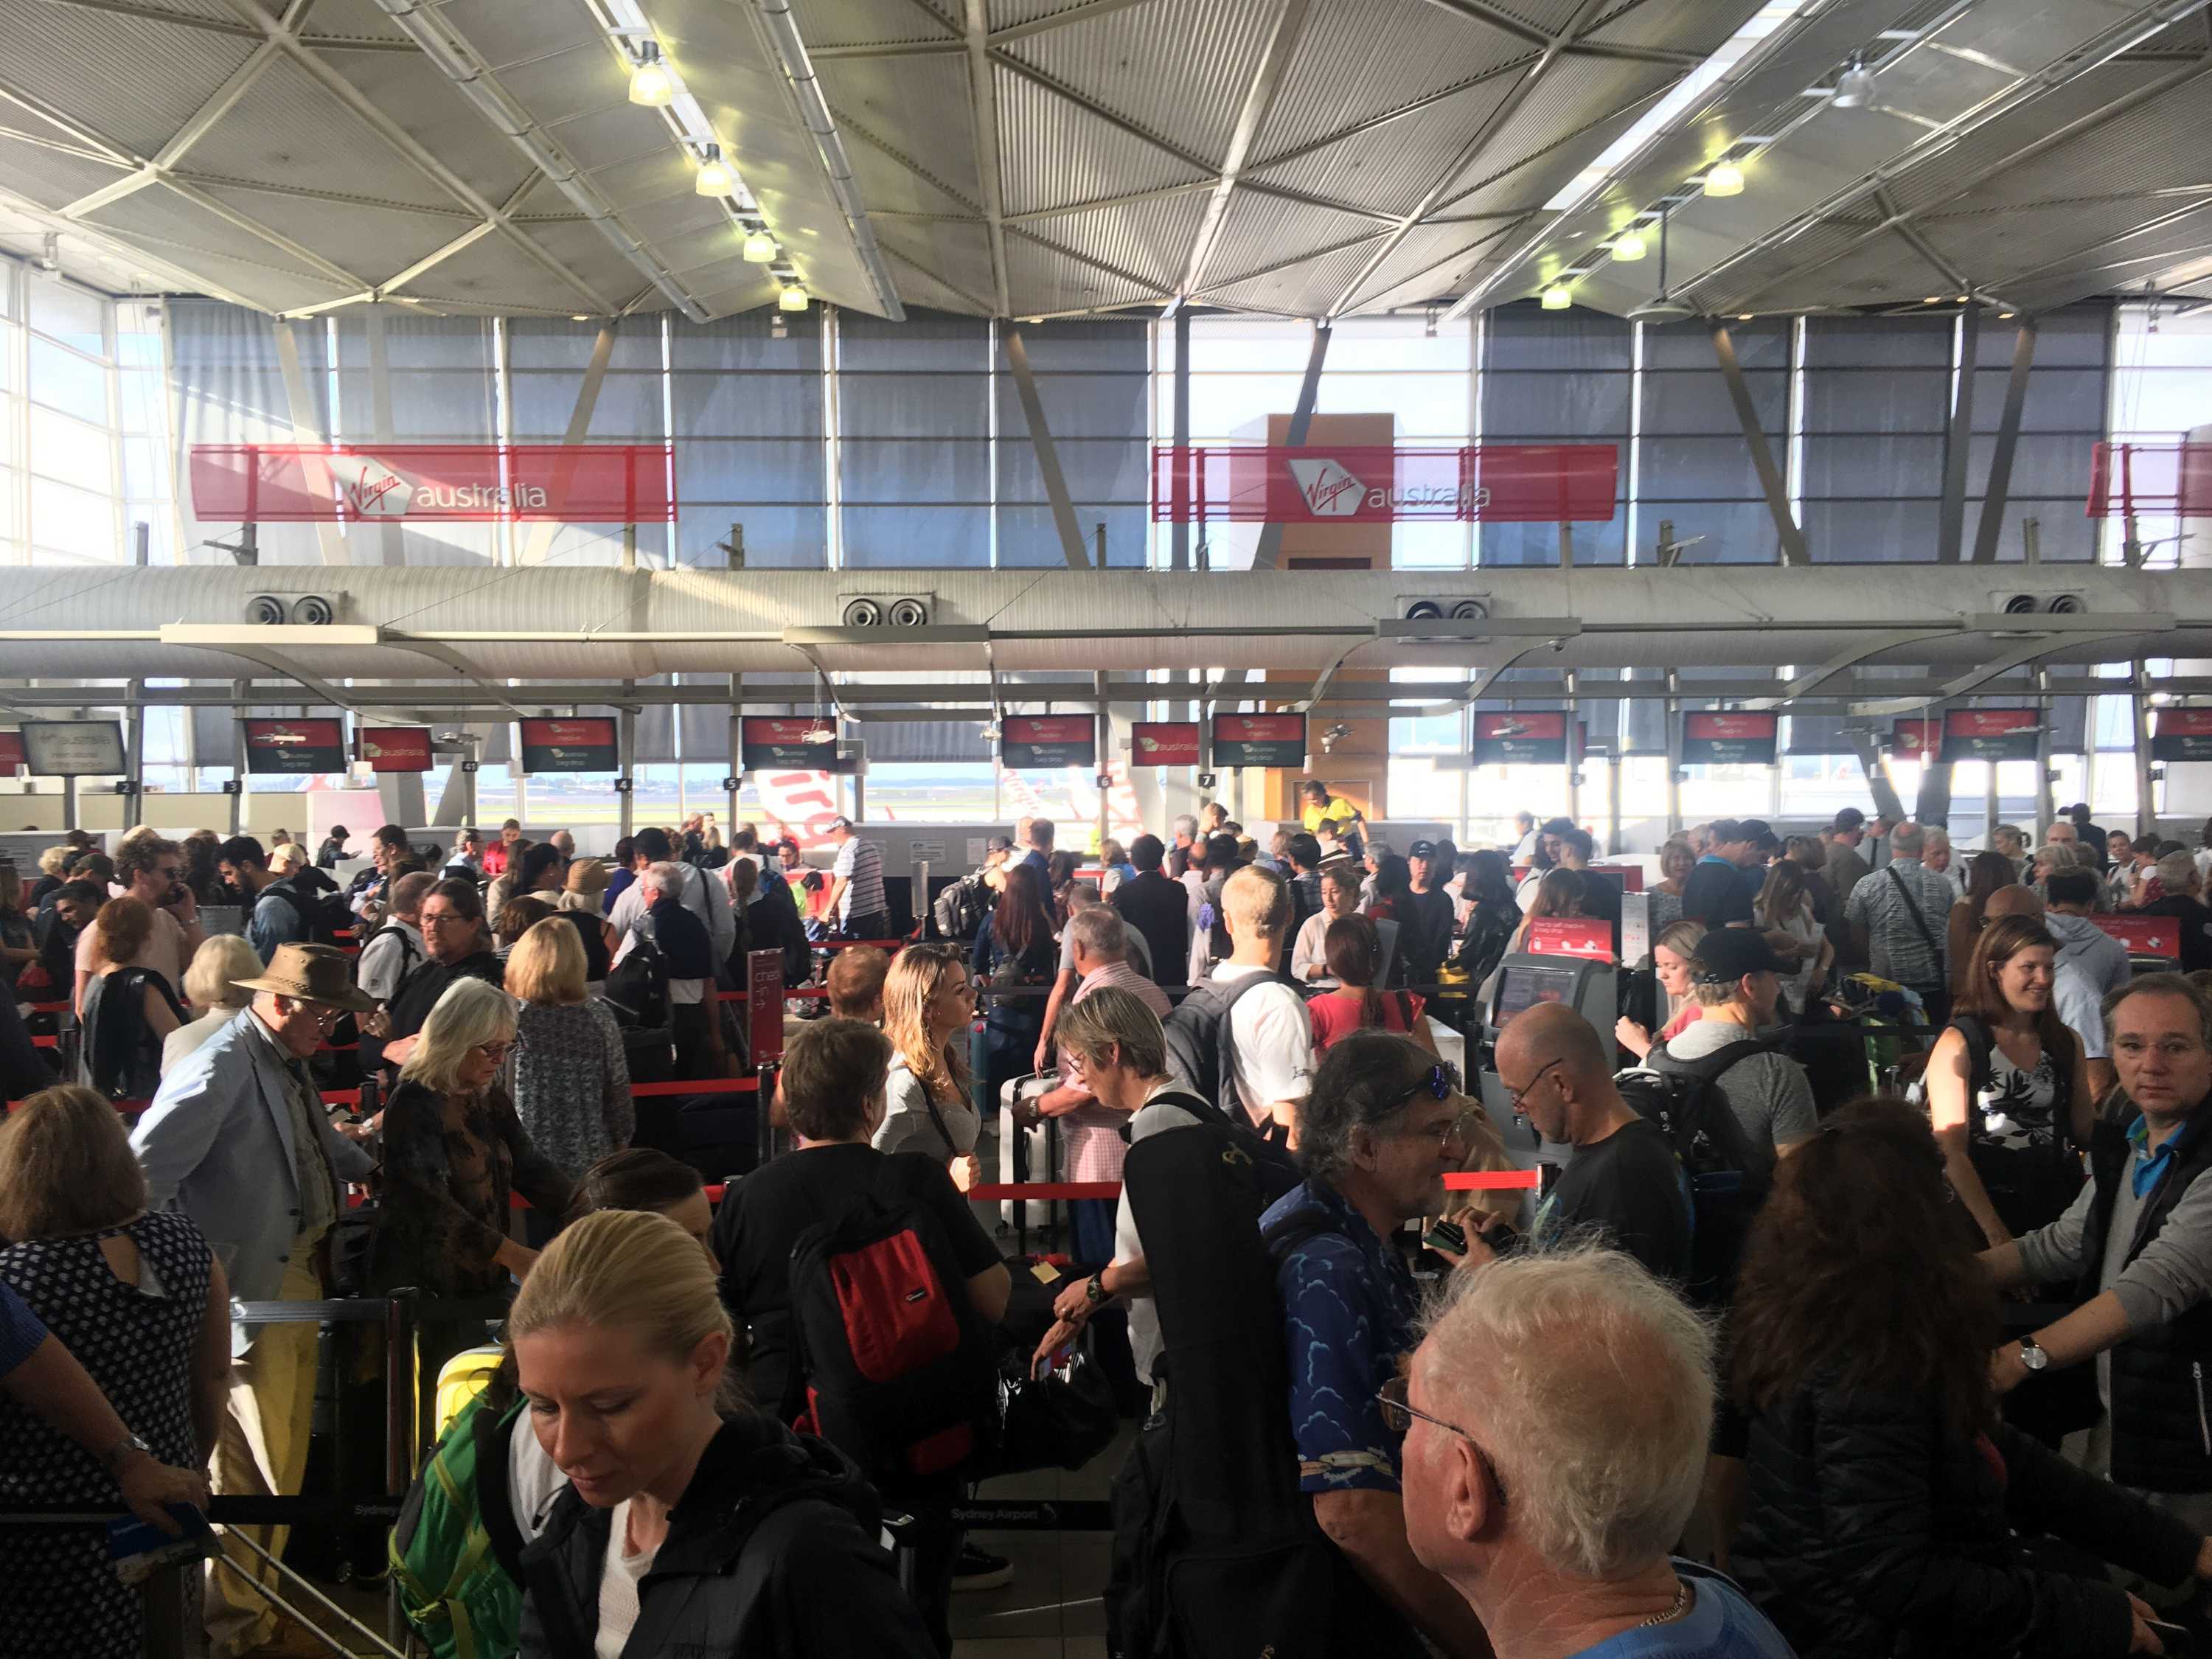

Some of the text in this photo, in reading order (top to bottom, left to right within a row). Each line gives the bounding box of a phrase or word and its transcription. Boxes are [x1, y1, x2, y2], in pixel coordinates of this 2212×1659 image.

[348, 466, 546, 511] Virgin australia
[1306, 467, 1491, 512] Virgin australia
[354, 1505, 399, 1517] Sydney
[950, 1508, 1039, 1521] Sydney Airport
